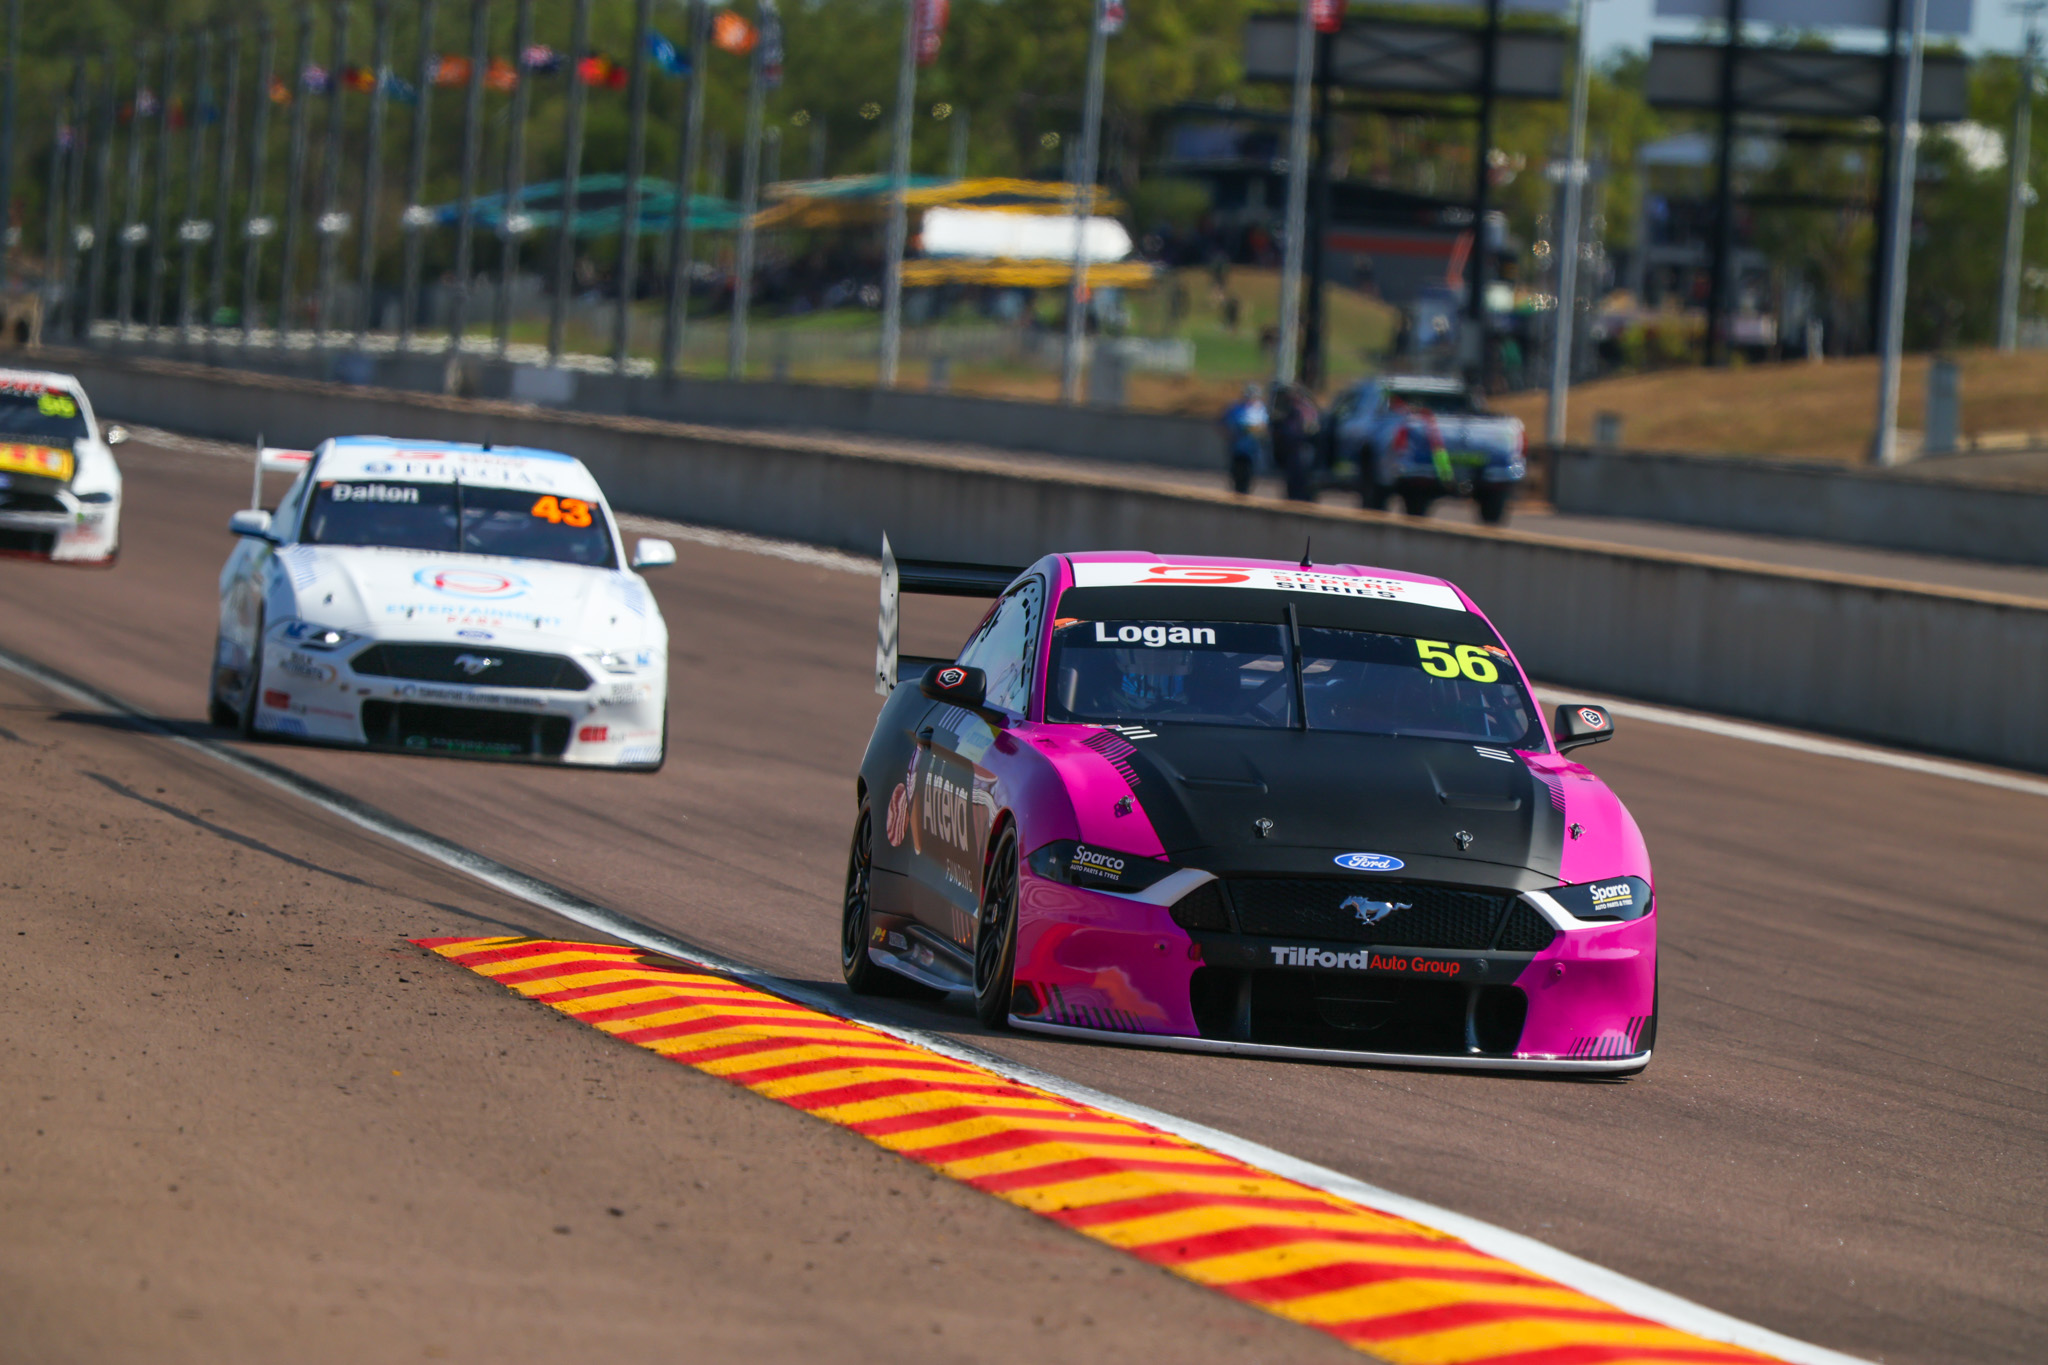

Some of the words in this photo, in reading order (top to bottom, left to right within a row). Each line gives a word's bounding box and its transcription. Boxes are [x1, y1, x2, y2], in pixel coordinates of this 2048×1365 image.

[331, 484, 419, 504] Dalton
[531, 495, 592, 528] 43
[1273, 575, 1405, 593] SUPER2
[1276, 581, 1396, 599] SERIES
[1095, 621, 1216, 648] Logan
[1415, 639, 1499, 683] 56
[923, 771, 969, 852] Arteva
[1073, 845, 1124, 870] Sparco
[1348, 855, 1391, 869] Ford
[945, 858, 973, 893] FUNDING
[1070, 864, 1083, 872] AUTO
[1083, 867, 1099, 876] PARTS
[1103, 872, 1120, 881] TYRES
[1589, 883, 1631, 903] Sparco
[1270, 946, 1369, 970] Tilford
[1370, 954, 1408, 971] Auto
[1411, 956, 1461, 977] Group
